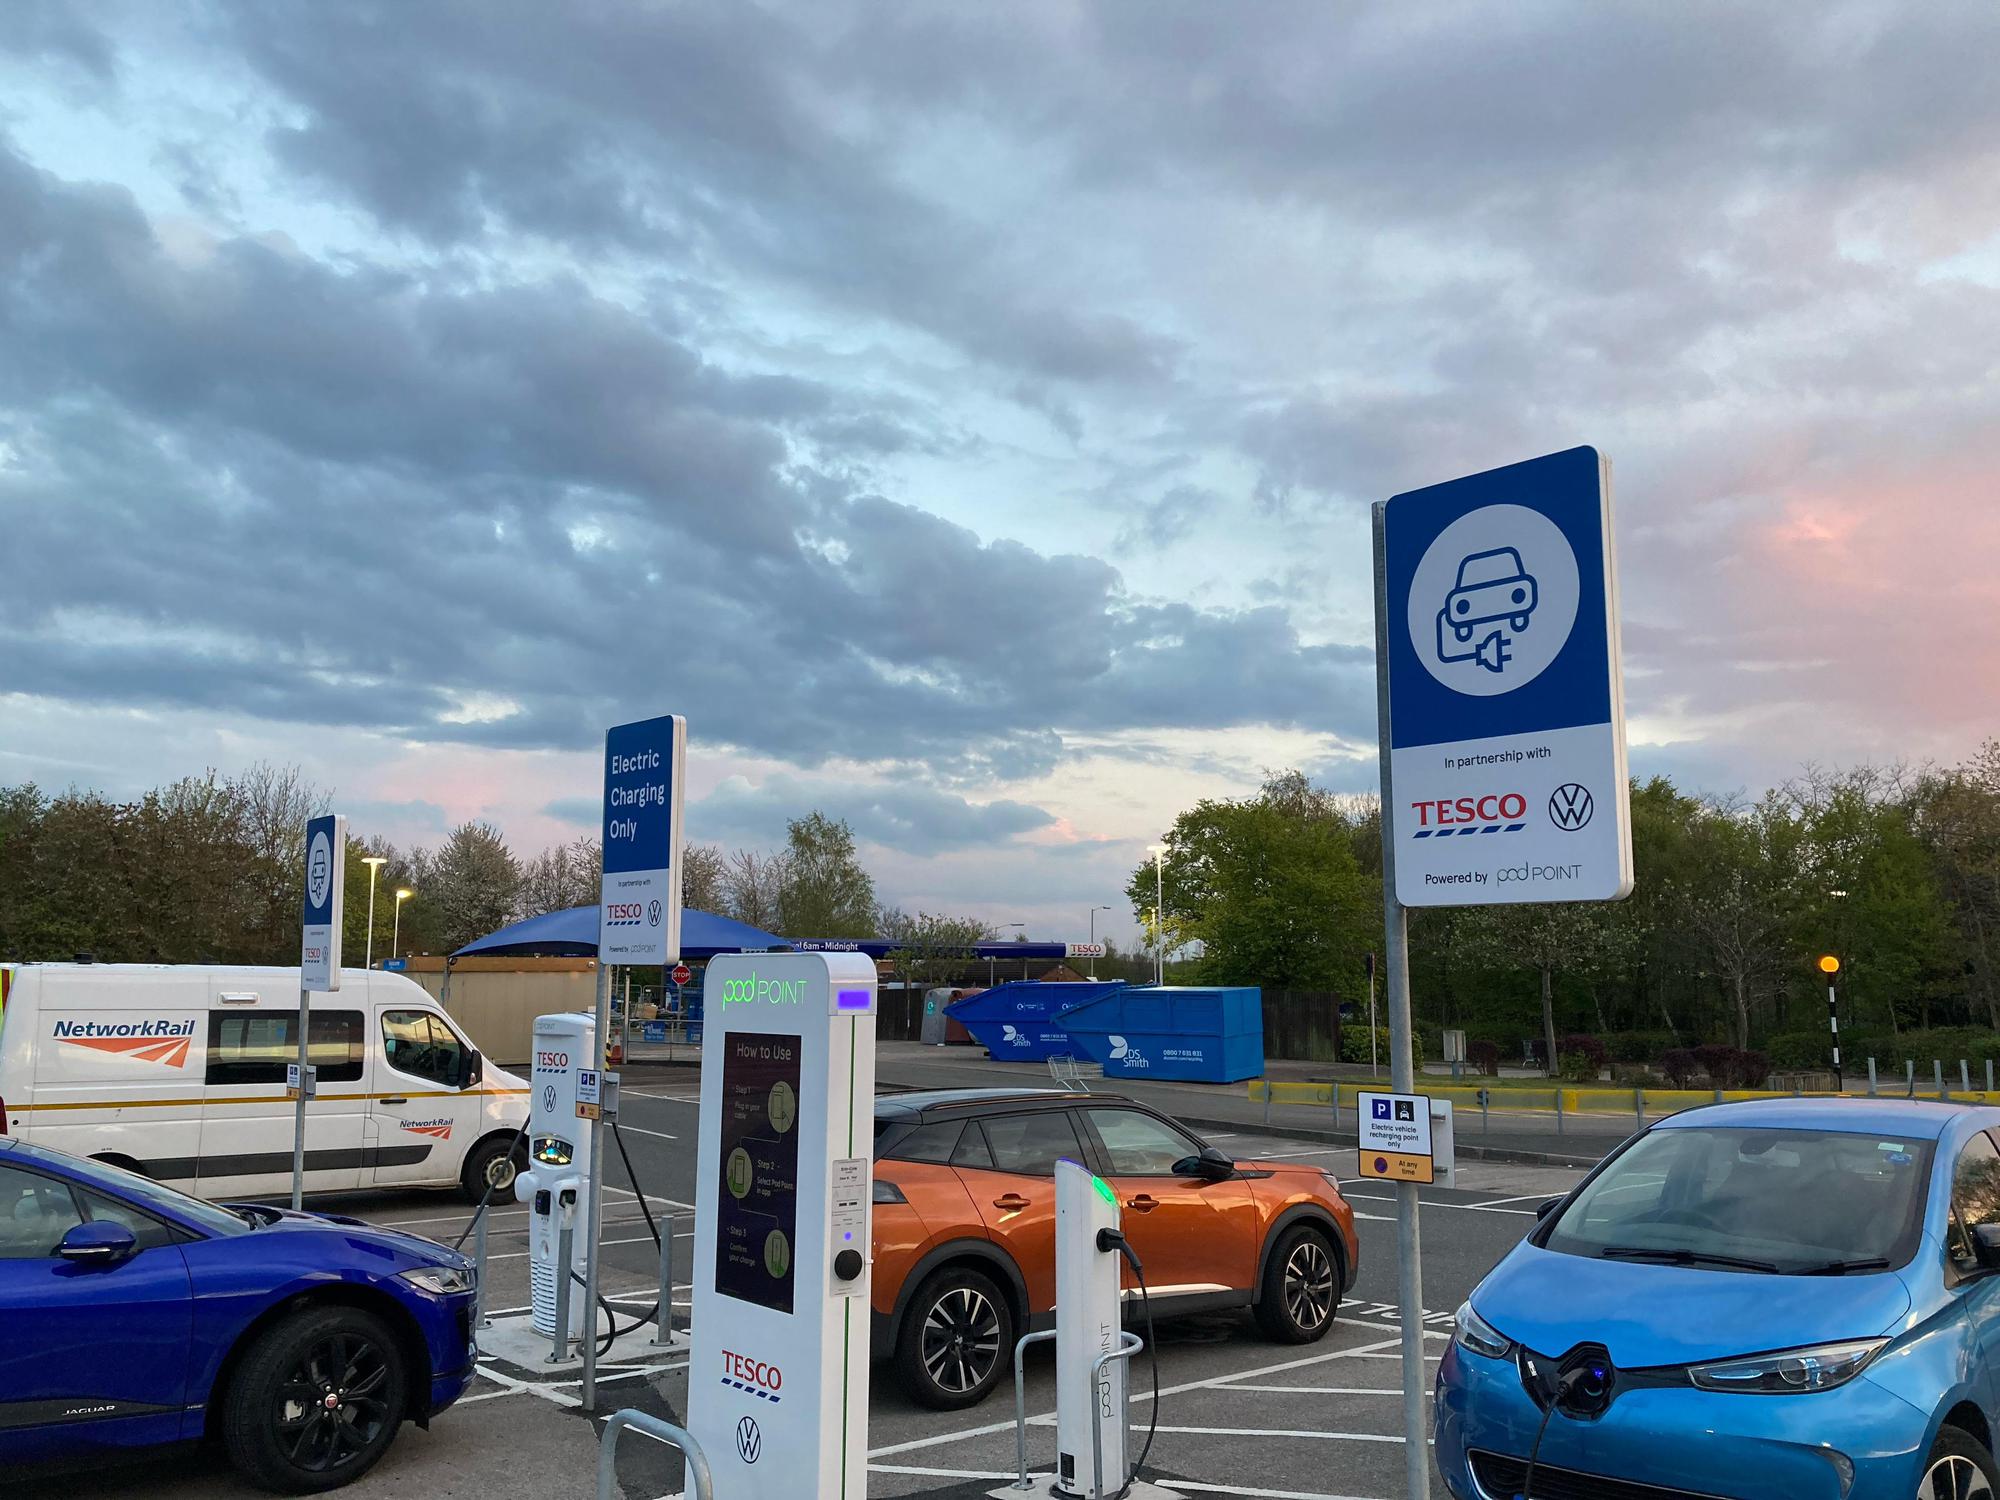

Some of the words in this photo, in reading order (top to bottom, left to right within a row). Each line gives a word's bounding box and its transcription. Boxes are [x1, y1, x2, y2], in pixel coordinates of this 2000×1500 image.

[612, 749, 660, 775] Electric
[1444, 757, 1455, 769] In
[1457, 749, 1523, 769] partnership
[1526, 746, 1551, 760] with
[611, 783, 665, 807] Charging
[1411, 793, 1527, 826] TESCO
[610, 818, 637, 842] Only
[1425, 872, 1472, 885] Powered
[1475, 871, 1488, 885] by
[1532, 864, 1583, 881] POINT
[607, 903, 642, 919] TESCO
[803, 941, 820, 950] 6am
[825, 941, 858, 951] Midnight
[1070, 944, 1102, 953] TESCO
[305, 947, 320, 959] TESCO
[722, 970, 756, 1012] pod
[757, 980, 808, 1005] POINT
[1016, 1033, 1025, 1041] DS
[1012, 1040, 1031, 1048] Smith
[737, 1042, 757, 1058] How
[761, 1047, 770, 1059] to
[773, 1045, 792, 1061] Use
[1128, 1049, 1140, 1060] DS
[537, 1052, 568, 1067] TESCO
[1123, 1058, 1149, 1068] Smith
[1371, 1123, 1394, 1132] Electric
[1369, 1131, 1402, 1141] recharging
[1387, 1141, 1401, 1149] only
[757, 1159, 770, 1171] Step
[770, 1161, 775, 1170] 2
[1406, 1161, 1418, 1169] any
[1402, 1168, 1416, 1176] time
[757, 1176, 771, 1186] Select
[772, 1178, 780, 1188] Pod
[761, 1189, 771, 1198] app
[721, 1349, 782, 1391] TESCO
[61, 1405, 116, 1416] JAGUAR
